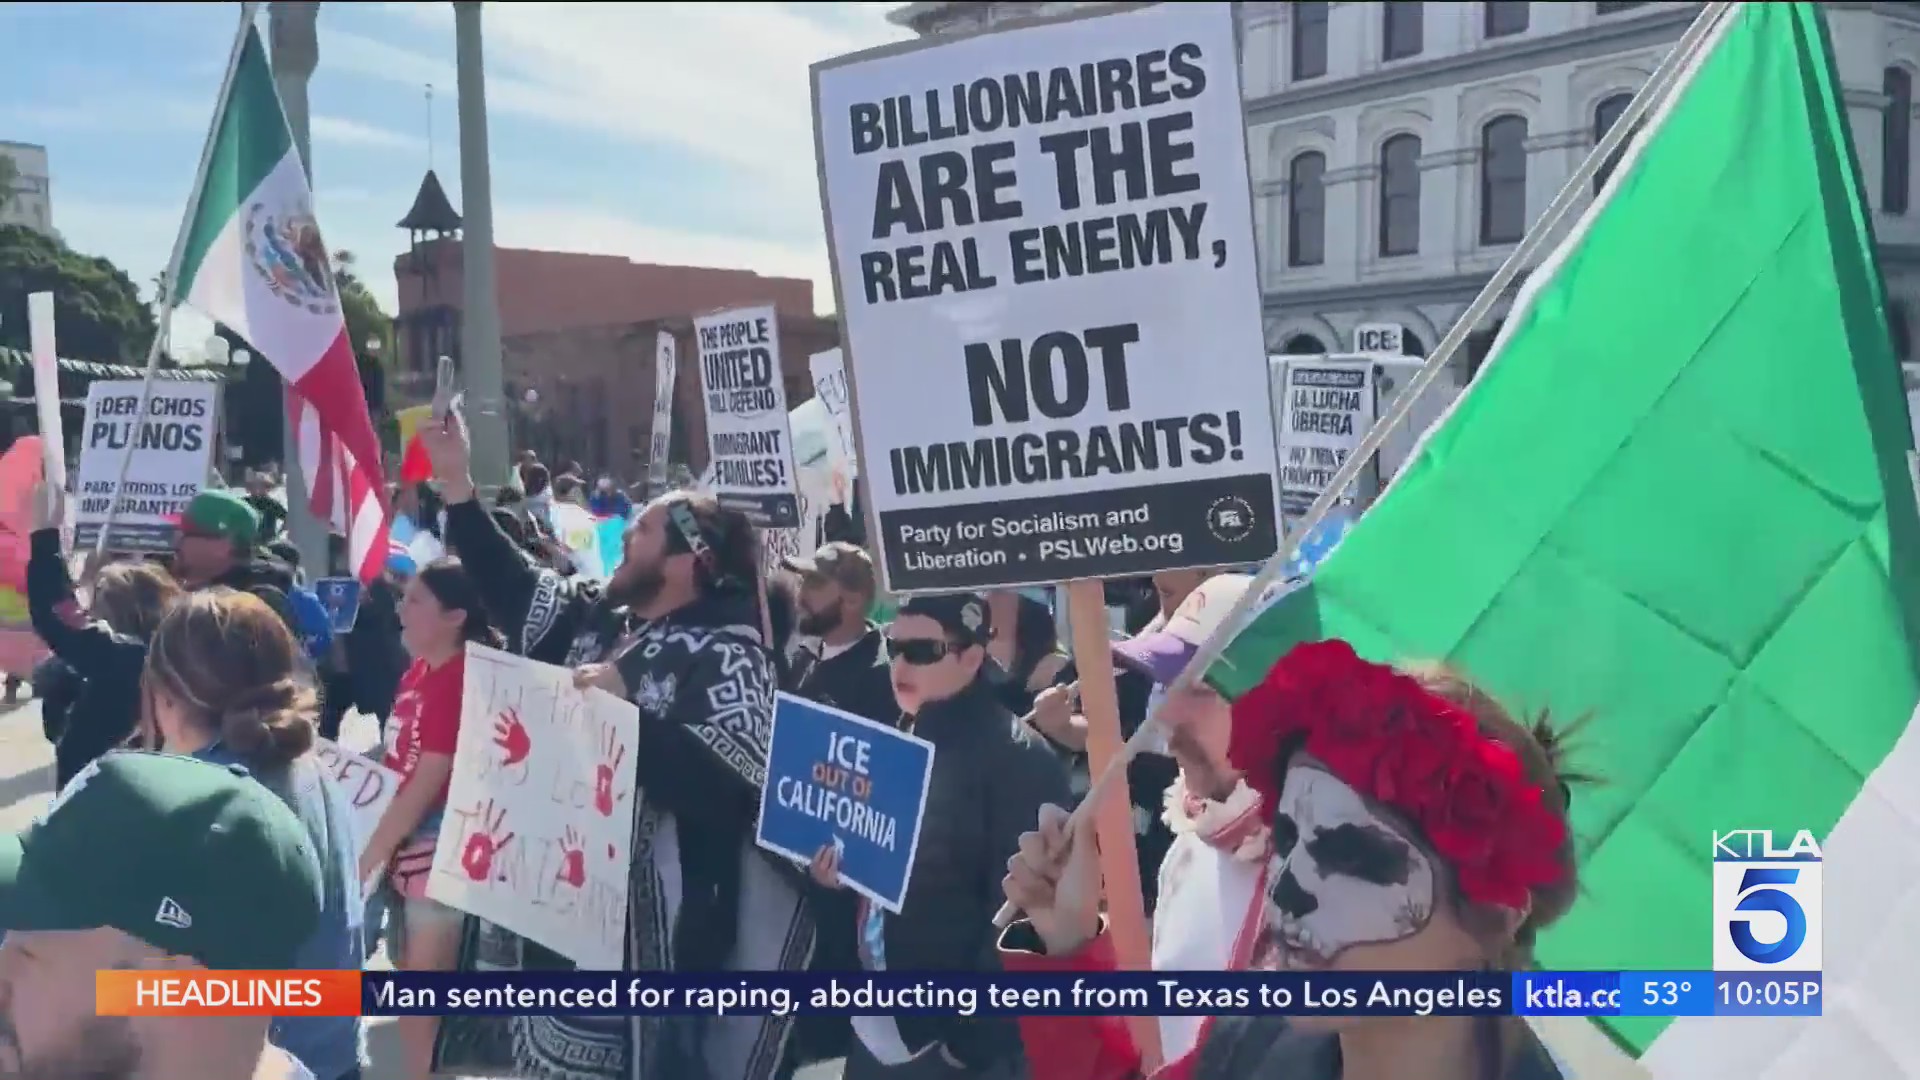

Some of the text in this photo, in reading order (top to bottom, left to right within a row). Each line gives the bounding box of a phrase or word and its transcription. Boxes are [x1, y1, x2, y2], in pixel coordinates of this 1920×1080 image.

[850, 43, 1206, 154] BILLIONAIRES
[873, 112, 1200, 238] ARE THE
[861, 203, 1226, 304] REAL ENEMY,
[700, 318, 769, 349] THE PEOPLE
[704, 346, 772, 390] UNITED
[965, 323, 1139, 426] NOT
[96, 396, 205, 418] ¡DERCHOS
[730, 387, 775, 412] DEFEND
[1313, 391, 1360, 411] LUCHA
[713, 430, 781, 455] IMMIGRANT
[1292, 412, 1352, 435] OBRERA
[890, 411, 1244, 494] IMMIGRANTS!
[124, 482, 167, 495] TODOS
[172, 483, 197, 496] LOS
[715, 459, 786, 486] FAMILIES!
[901, 504, 1150, 545] Party for Socialism and
[904, 532, 1184, 570] Liberation PSLWeb.org
[828, 731, 871, 775] ICE
[812, 763, 873, 798] OUT OF
[777, 776, 897, 852] CALIFORNIA
